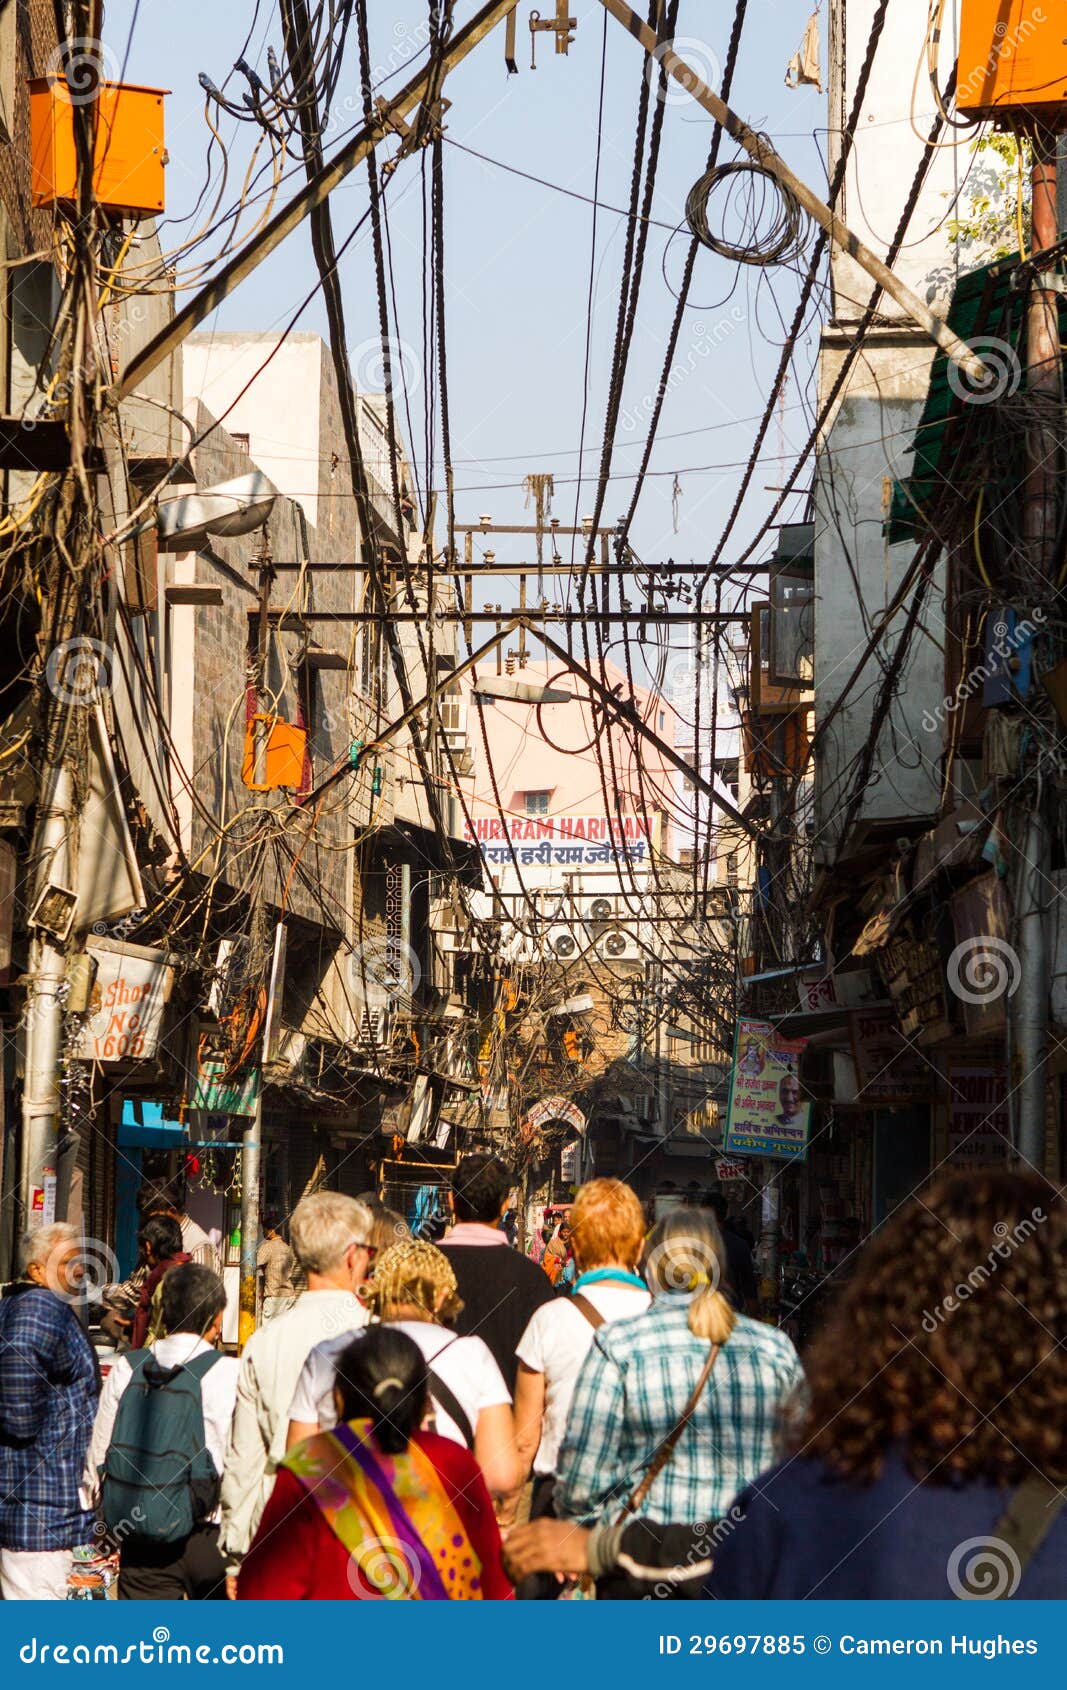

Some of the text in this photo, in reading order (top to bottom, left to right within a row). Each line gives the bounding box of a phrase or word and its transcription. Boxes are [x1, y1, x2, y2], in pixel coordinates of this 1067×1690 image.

[512, 818, 554, 840] RAM
[560, 817, 606, 839] HARI
[520, 842, 553, 865] हरी
[553, 846, 585, 864] राम
